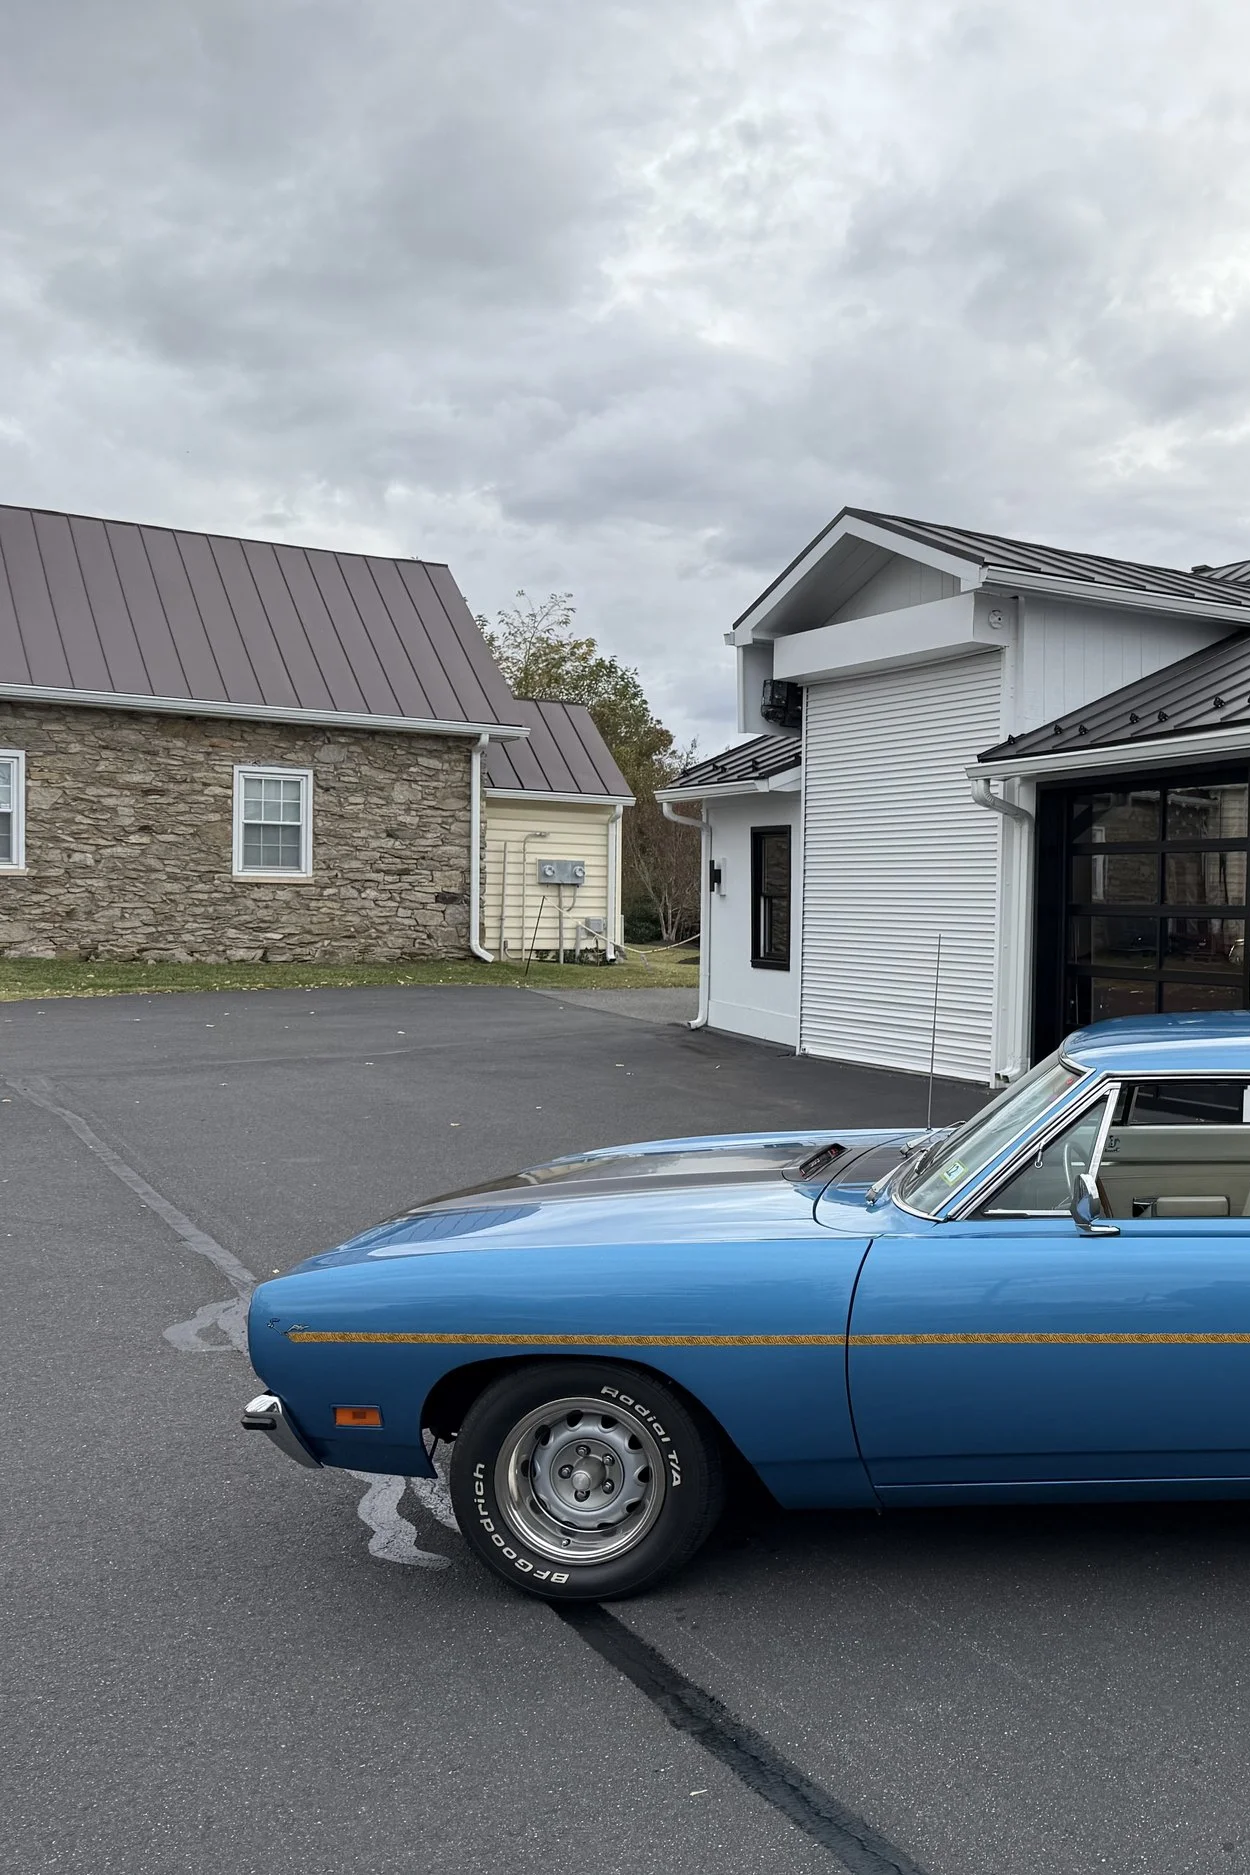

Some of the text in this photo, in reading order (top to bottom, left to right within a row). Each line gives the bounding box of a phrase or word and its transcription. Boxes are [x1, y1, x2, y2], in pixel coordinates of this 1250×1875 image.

[600, 1385, 682, 1488] Radial T/A
[472, 1463, 570, 1585] BFGoodrich
